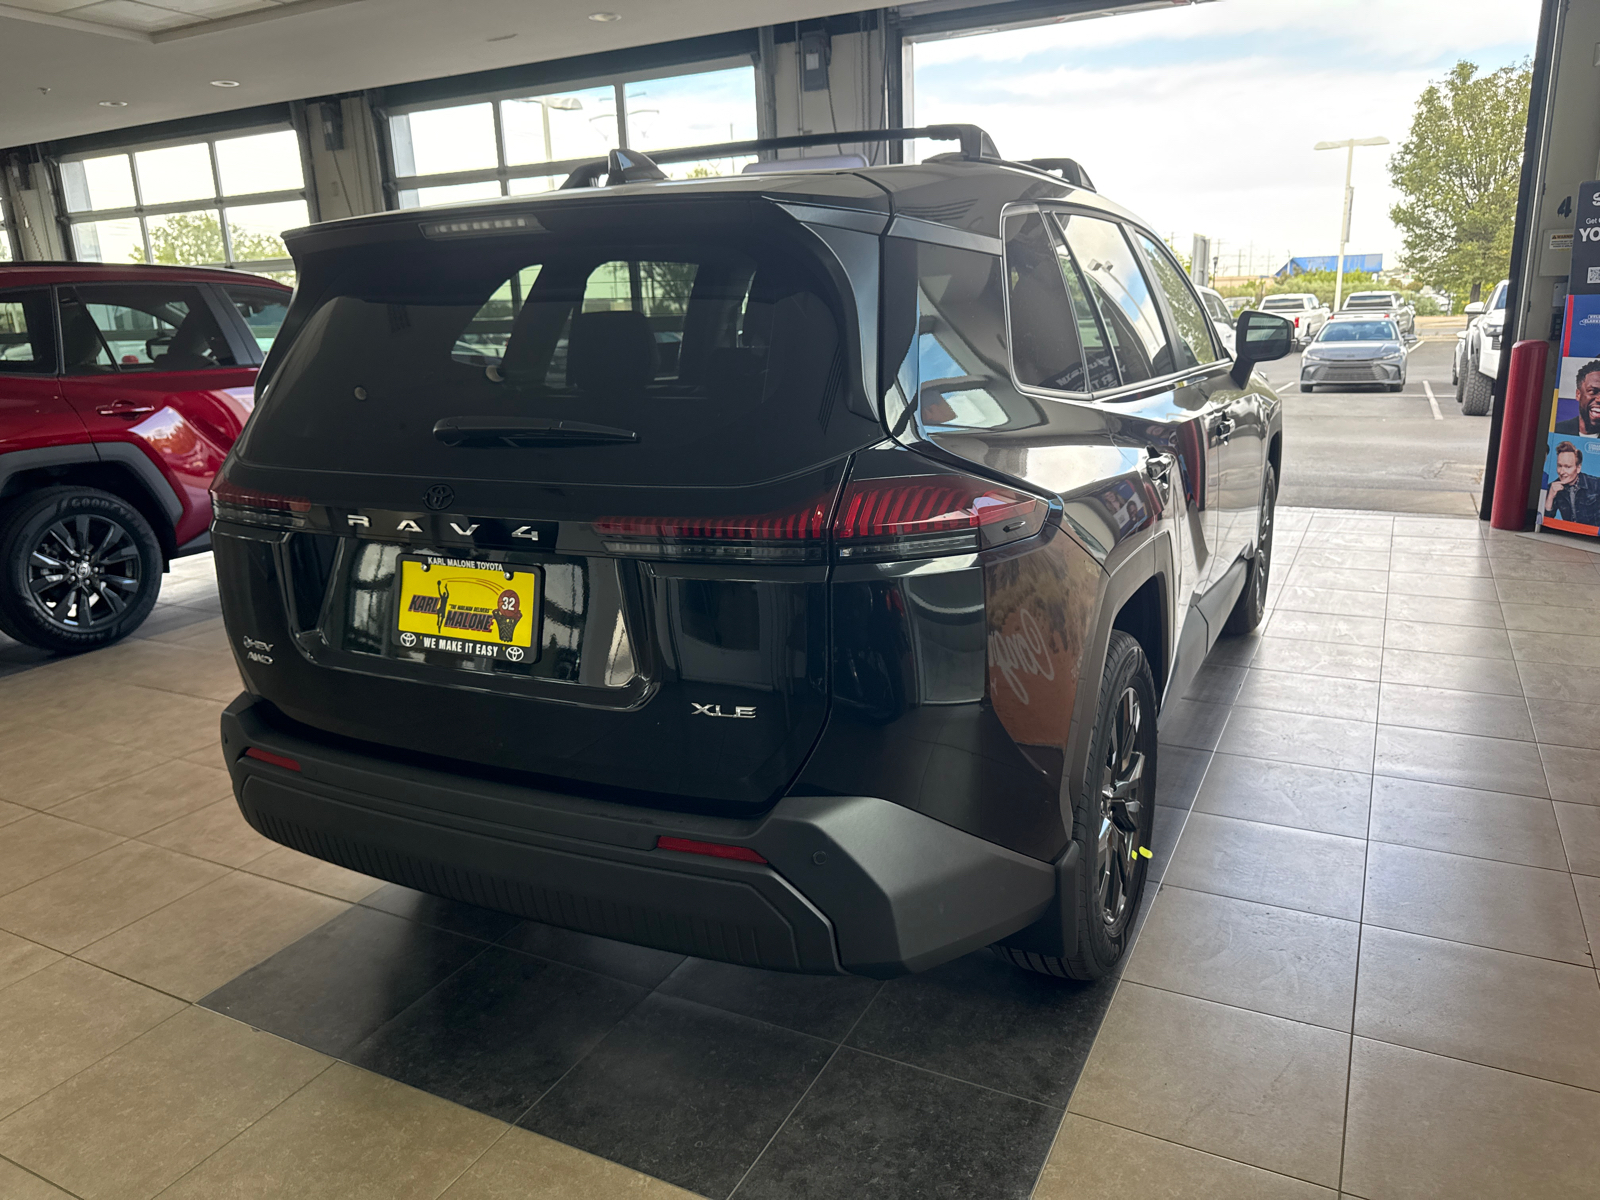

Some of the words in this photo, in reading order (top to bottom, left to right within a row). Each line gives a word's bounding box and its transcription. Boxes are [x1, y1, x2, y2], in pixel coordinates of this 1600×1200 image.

[1557, 195, 1572, 219] 4
[1586, 217, 1597, 225] Get
[427, 556, 446, 566] KARL
[447, 558, 476, 569] MALONE
[476, 561, 504, 572] TOYOTA
[408, 594, 440, 615] KARL
[501, 596, 516, 611] 32
[444, 610, 494, 633] MALONE
[423, 636, 437, 649] WE
[438, 638, 463, 652] MAKE
[464, 642, 474, 654] IT
[475, 643, 499, 657] EASY
[691, 702, 757, 719] XLE
